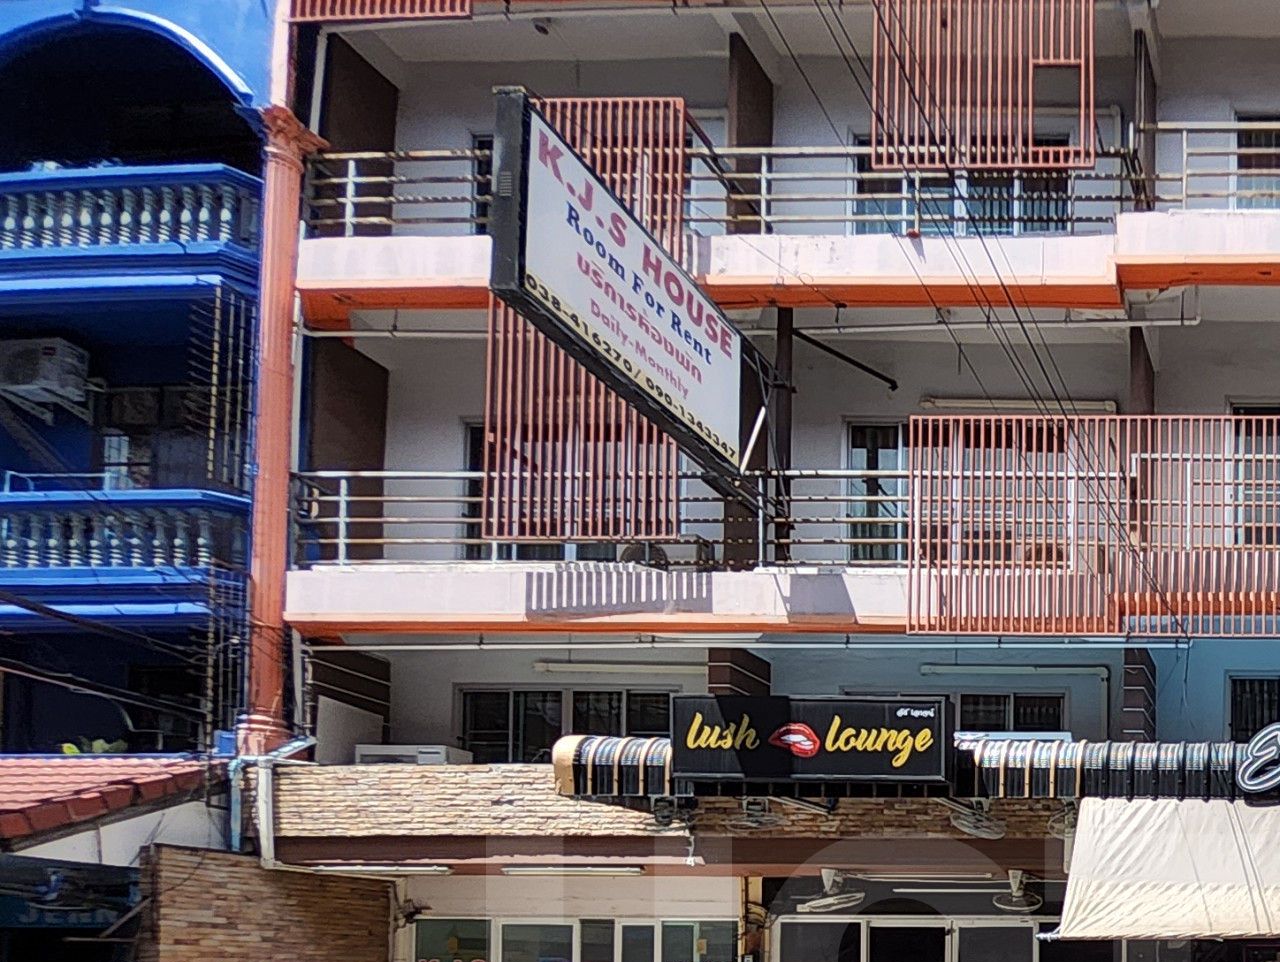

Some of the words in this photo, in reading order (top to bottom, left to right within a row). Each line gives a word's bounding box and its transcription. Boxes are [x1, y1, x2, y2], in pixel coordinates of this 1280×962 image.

[538, 128, 628, 248] K.J.S
[642, 243, 733, 360] HOUSE
[566, 200, 626, 282] Room
[631, 270, 665, 318] For
[670, 309, 712, 366] Rent
[686, 711, 760, 750] lush
[824, 714, 934, 768] lounge
